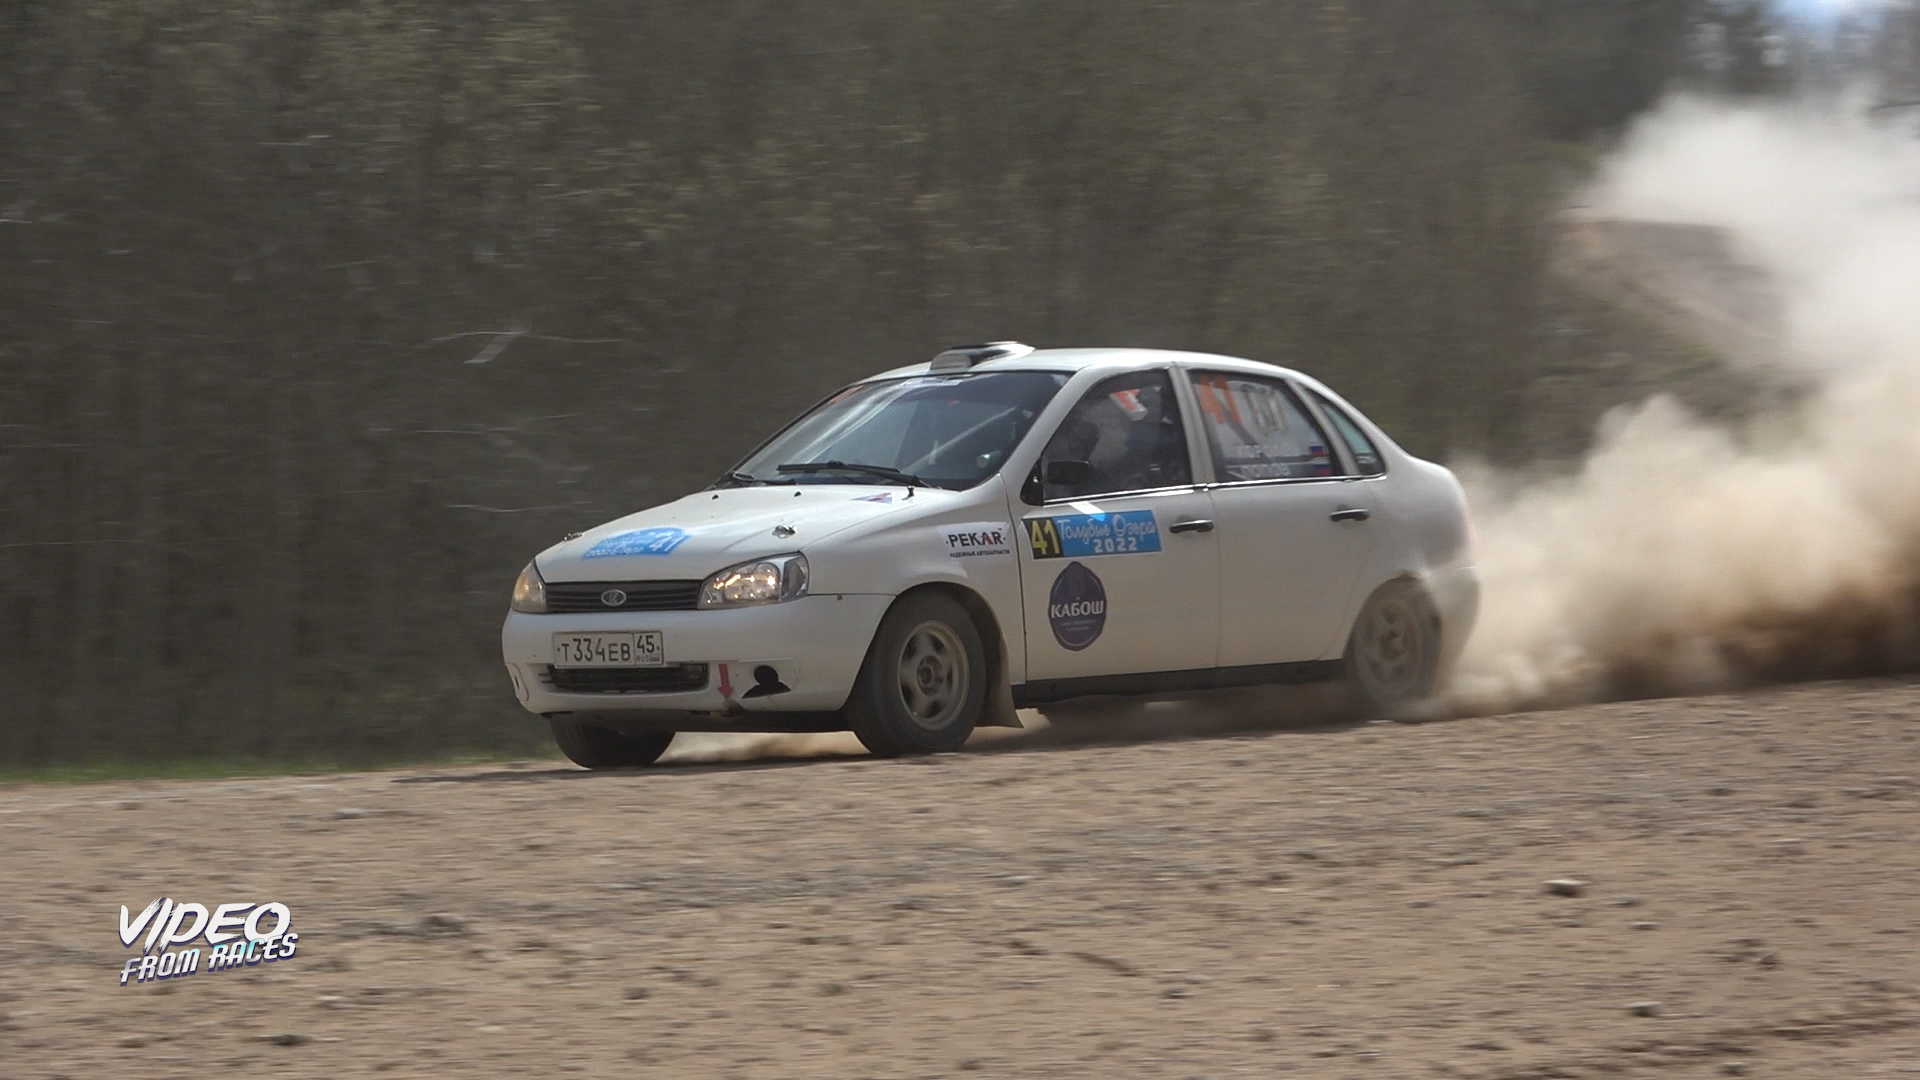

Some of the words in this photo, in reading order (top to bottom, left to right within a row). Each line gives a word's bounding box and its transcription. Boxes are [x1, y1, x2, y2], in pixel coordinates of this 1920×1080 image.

[1031, 519, 1060, 555] 41
[1113, 514, 1155, 541] Озера
[649, 531, 684, 552] 41
[947, 531, 1004, 547] PEKAR
[1094, 537, 1138, 553] 2022
[1051, 600, 1104, 618] КАБОШ
[637, 634, 655, 654] 45
